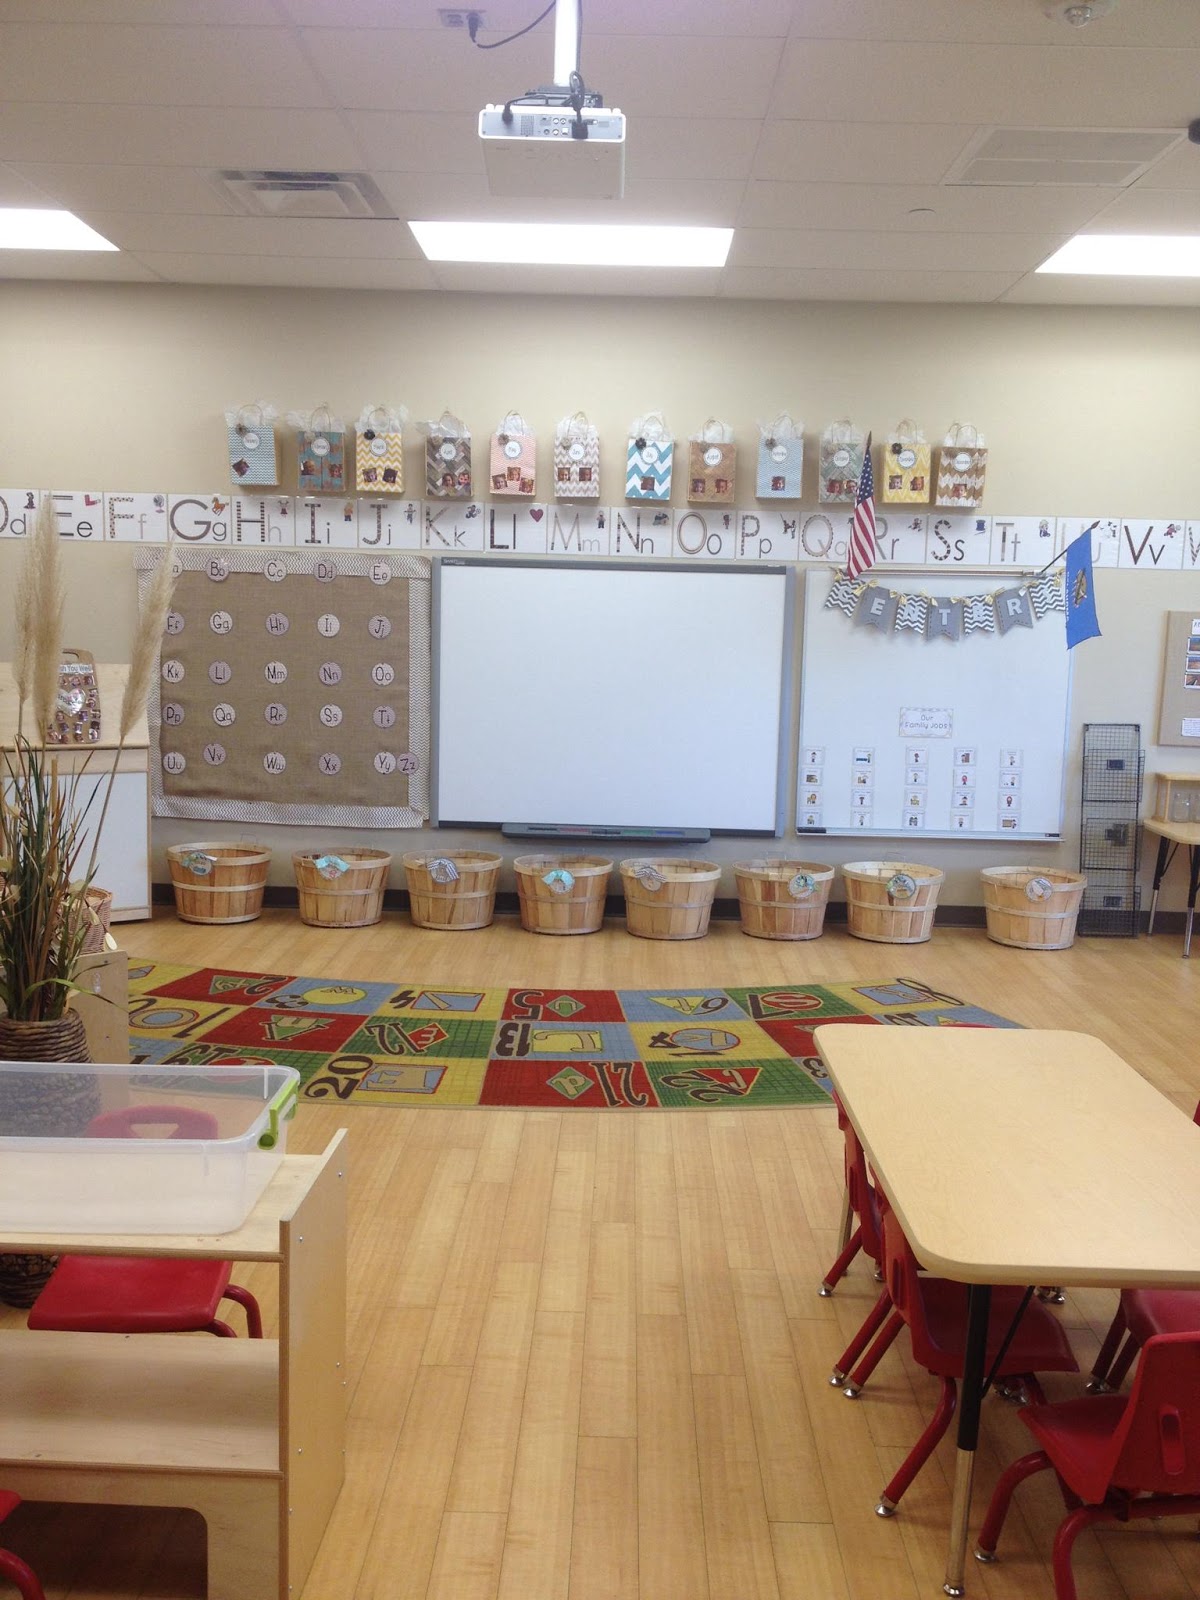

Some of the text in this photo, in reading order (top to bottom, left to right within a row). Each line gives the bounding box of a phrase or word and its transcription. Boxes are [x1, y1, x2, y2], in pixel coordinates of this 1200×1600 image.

[109, 497, 147, 539] Ff
[169, 499, 227, 542] Gg
[236, 501, 283, 542] Hh
[304, 503, 331, 544] Ii
[362, 503, 392, 546] Jj
[425, 505, 467, 548] Kk
[550, 511, 600, 552] Mm
[616, 512, 655, 554] Nn
[677, 511, 722, 555] Oo
[740, 515, 773, 559] Pp
[930, 519, 966, 562] Ss
[995, 522, 1021, 562] Tt
[1123, 525, 1166, 566] Vv
[209, 561, 226, 577] Bb
[267, 561, 283, 578] Cc
[318, 563, 334, 579] Dd
[373, 565, 388, 581] Ee
[167, 615, 181, 632] Ff
[212, 614, 230, 632] Gg
[269, 617, 286, 632] Hh
[374, 619, 386, 637] Jj
[167, 666, 180, 679] Kk
[267, 666, 286, 680] Mm
[323, 667, 339, 681] Nn
[375, 666, 392, 682] Oo
[166, 706, 391, 724] Pp Qq Rr Ss Tt
[904, 721, 929, 730] Family
[166, 747, 416, 772] Uu Vv Ww Xx Yy Zz
[512, 990, 544, 1021] 5
[748, 994, 795, 1020] 7
[495, 1022, 531, 1057] 13
[304, 1055, 374, 1099] 20
[589, 1061, 649, 1108] 21
